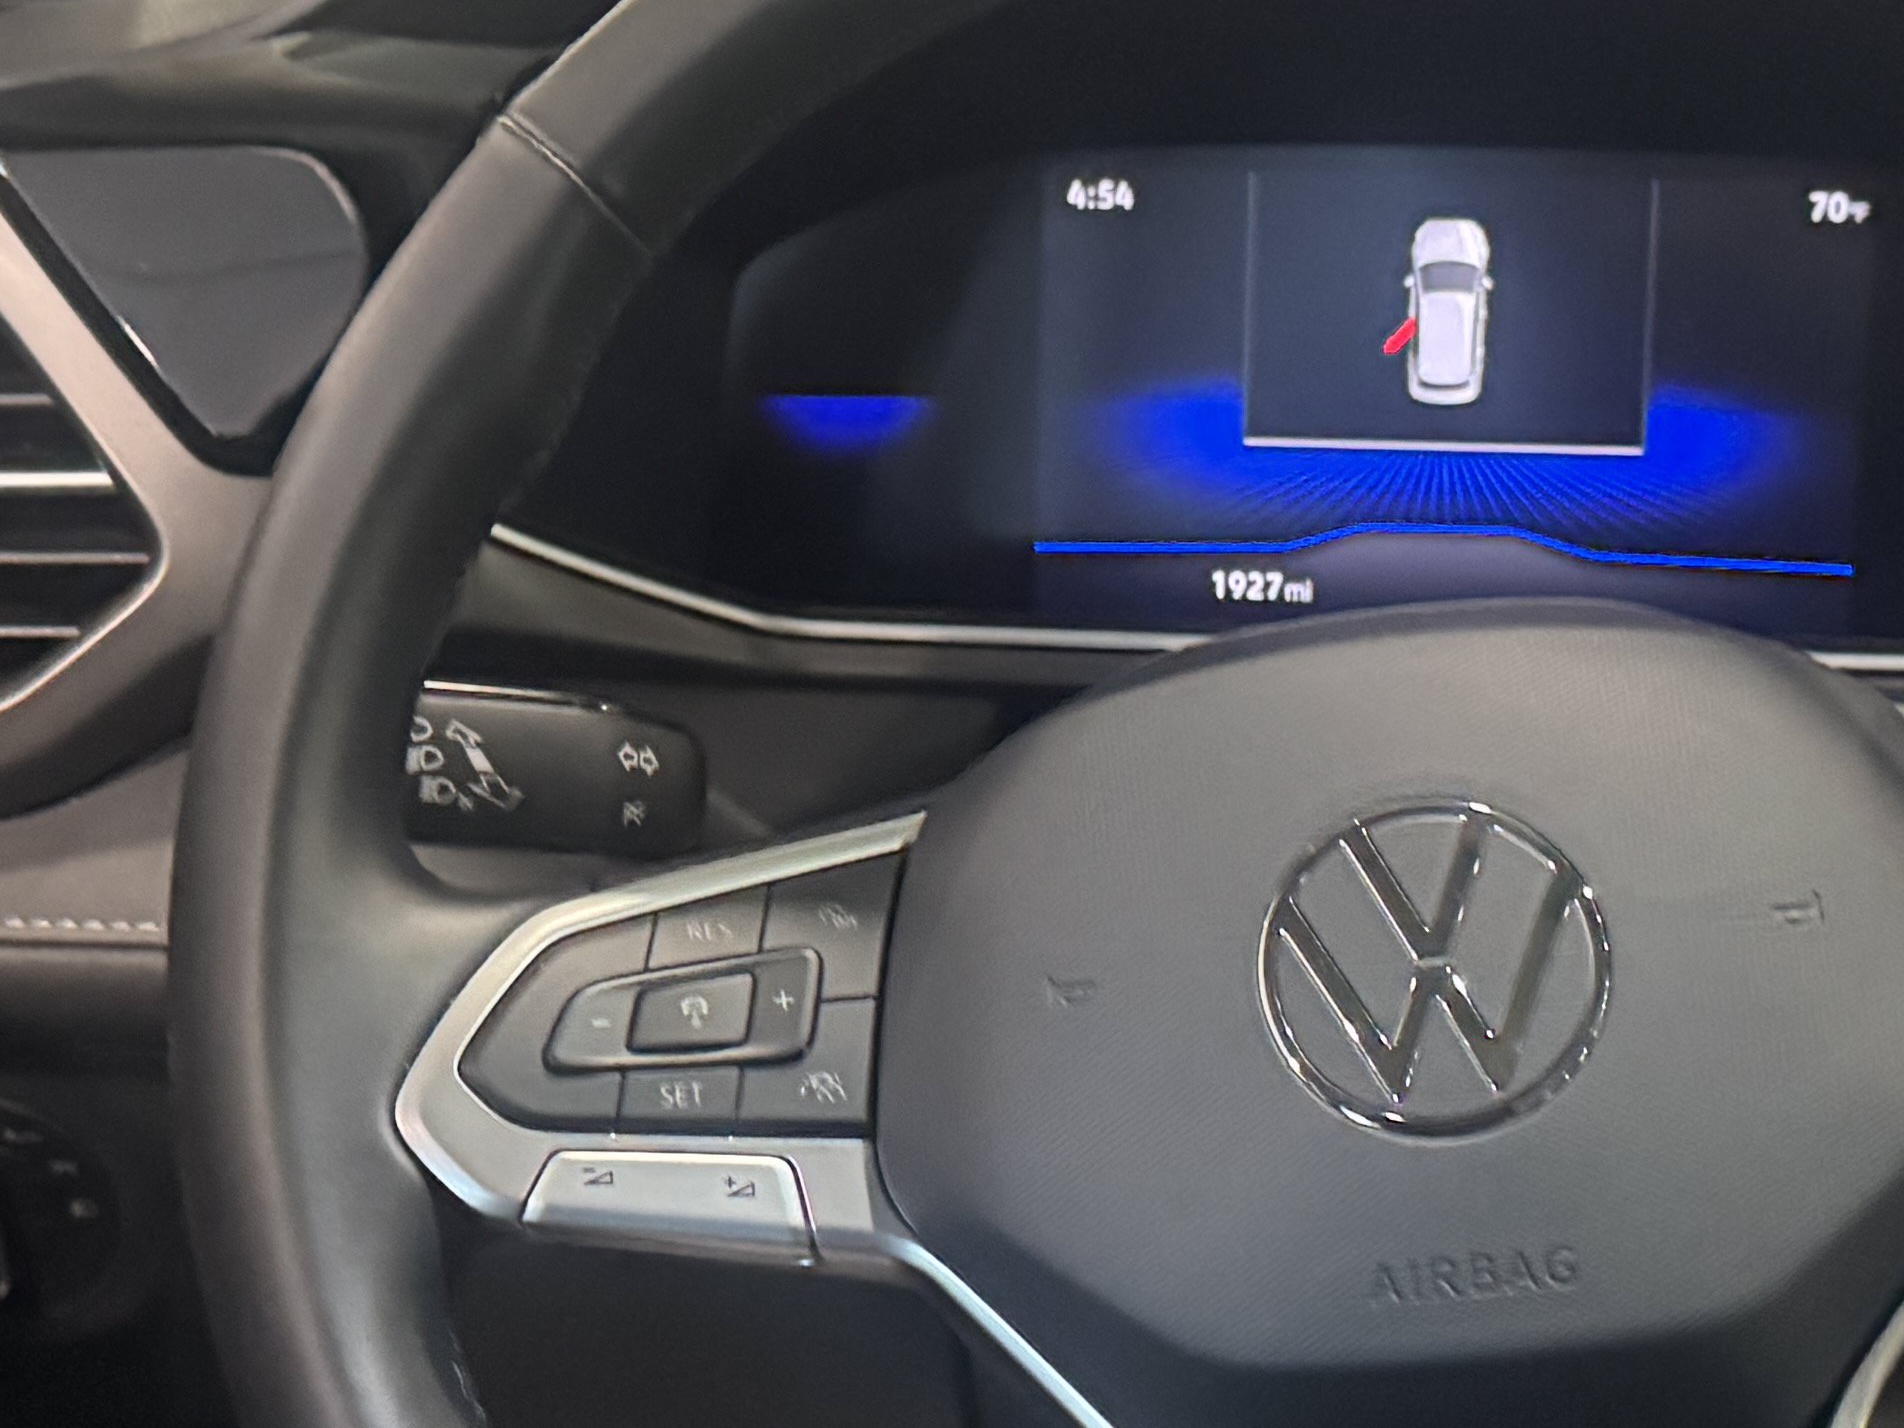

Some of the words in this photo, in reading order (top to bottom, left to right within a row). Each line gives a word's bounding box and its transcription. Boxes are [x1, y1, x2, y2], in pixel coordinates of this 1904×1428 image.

[1066, 178, 1135, 211] 4:54
[659, 1080, 703, 1110] SET
[1368, 1242, 1582, 1308] AIRBAG
